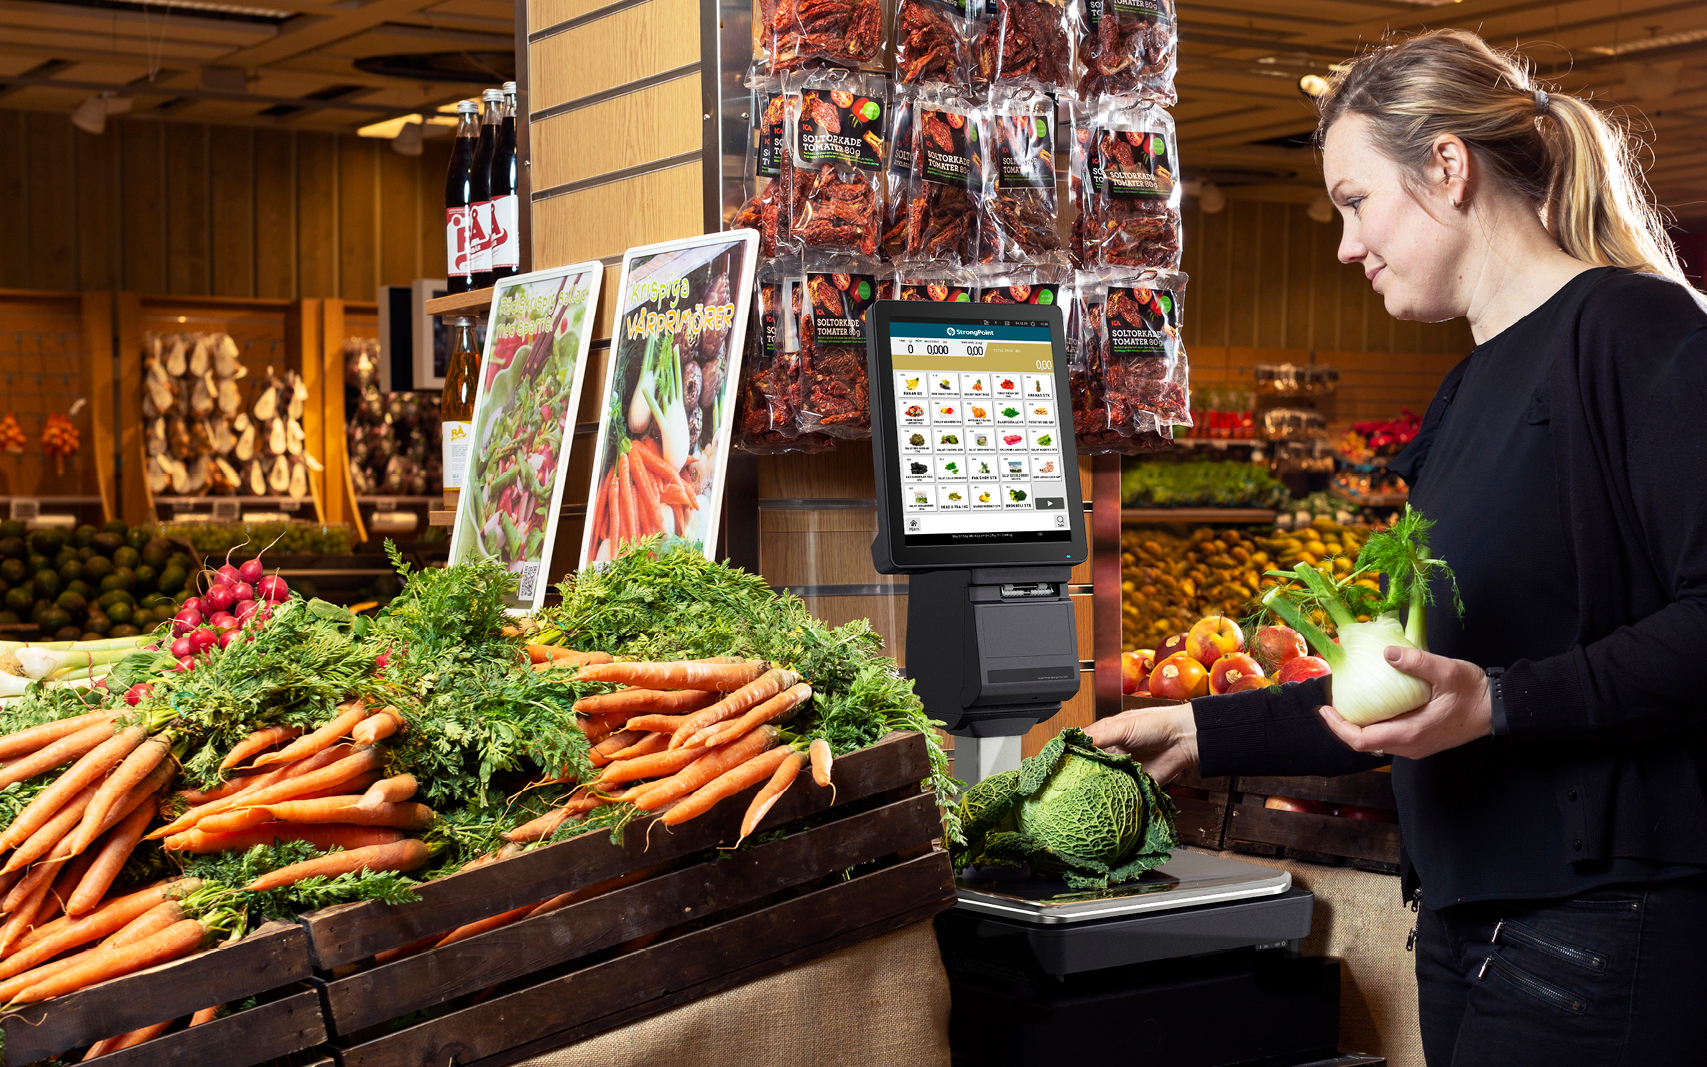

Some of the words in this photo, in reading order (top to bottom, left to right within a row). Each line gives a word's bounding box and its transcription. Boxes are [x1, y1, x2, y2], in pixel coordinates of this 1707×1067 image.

[802, 124, 813, 132] ICA
[802, 134, 862, 147] SOLTORKADE
[802, 143, 844, 153] TOMATER
[844, 146, 861, 157] 80g
[928, 150, 970, 166] SOLTORKADE
[928, 158, 959, 172] TOMATER
[1110, 172, 1156, 181] SOLTORKADE
[1113, 178, 1146, 187] TOMATER
[630, 272, 690, 311] Krispiga
[627, 302, 734, 340] VÅRPRIMÖRER
[817, 318, 860, 327] SOLTORKADE
[496, 318, 516, 339] med
[817, 327, 848, 336] TOMATER
[956, 329, 994, 337] StrongPoint
[1112, 329, 1161, 338] SOLTORKADE
[1113, 338, 1148, 346] TOMATER
[908, 344, 914, 354] 0
[926, 345, 949, 355] 0,000
[967, 346, 984, 356] 0,00
[1036, 360, 1052, 371] 0,00
